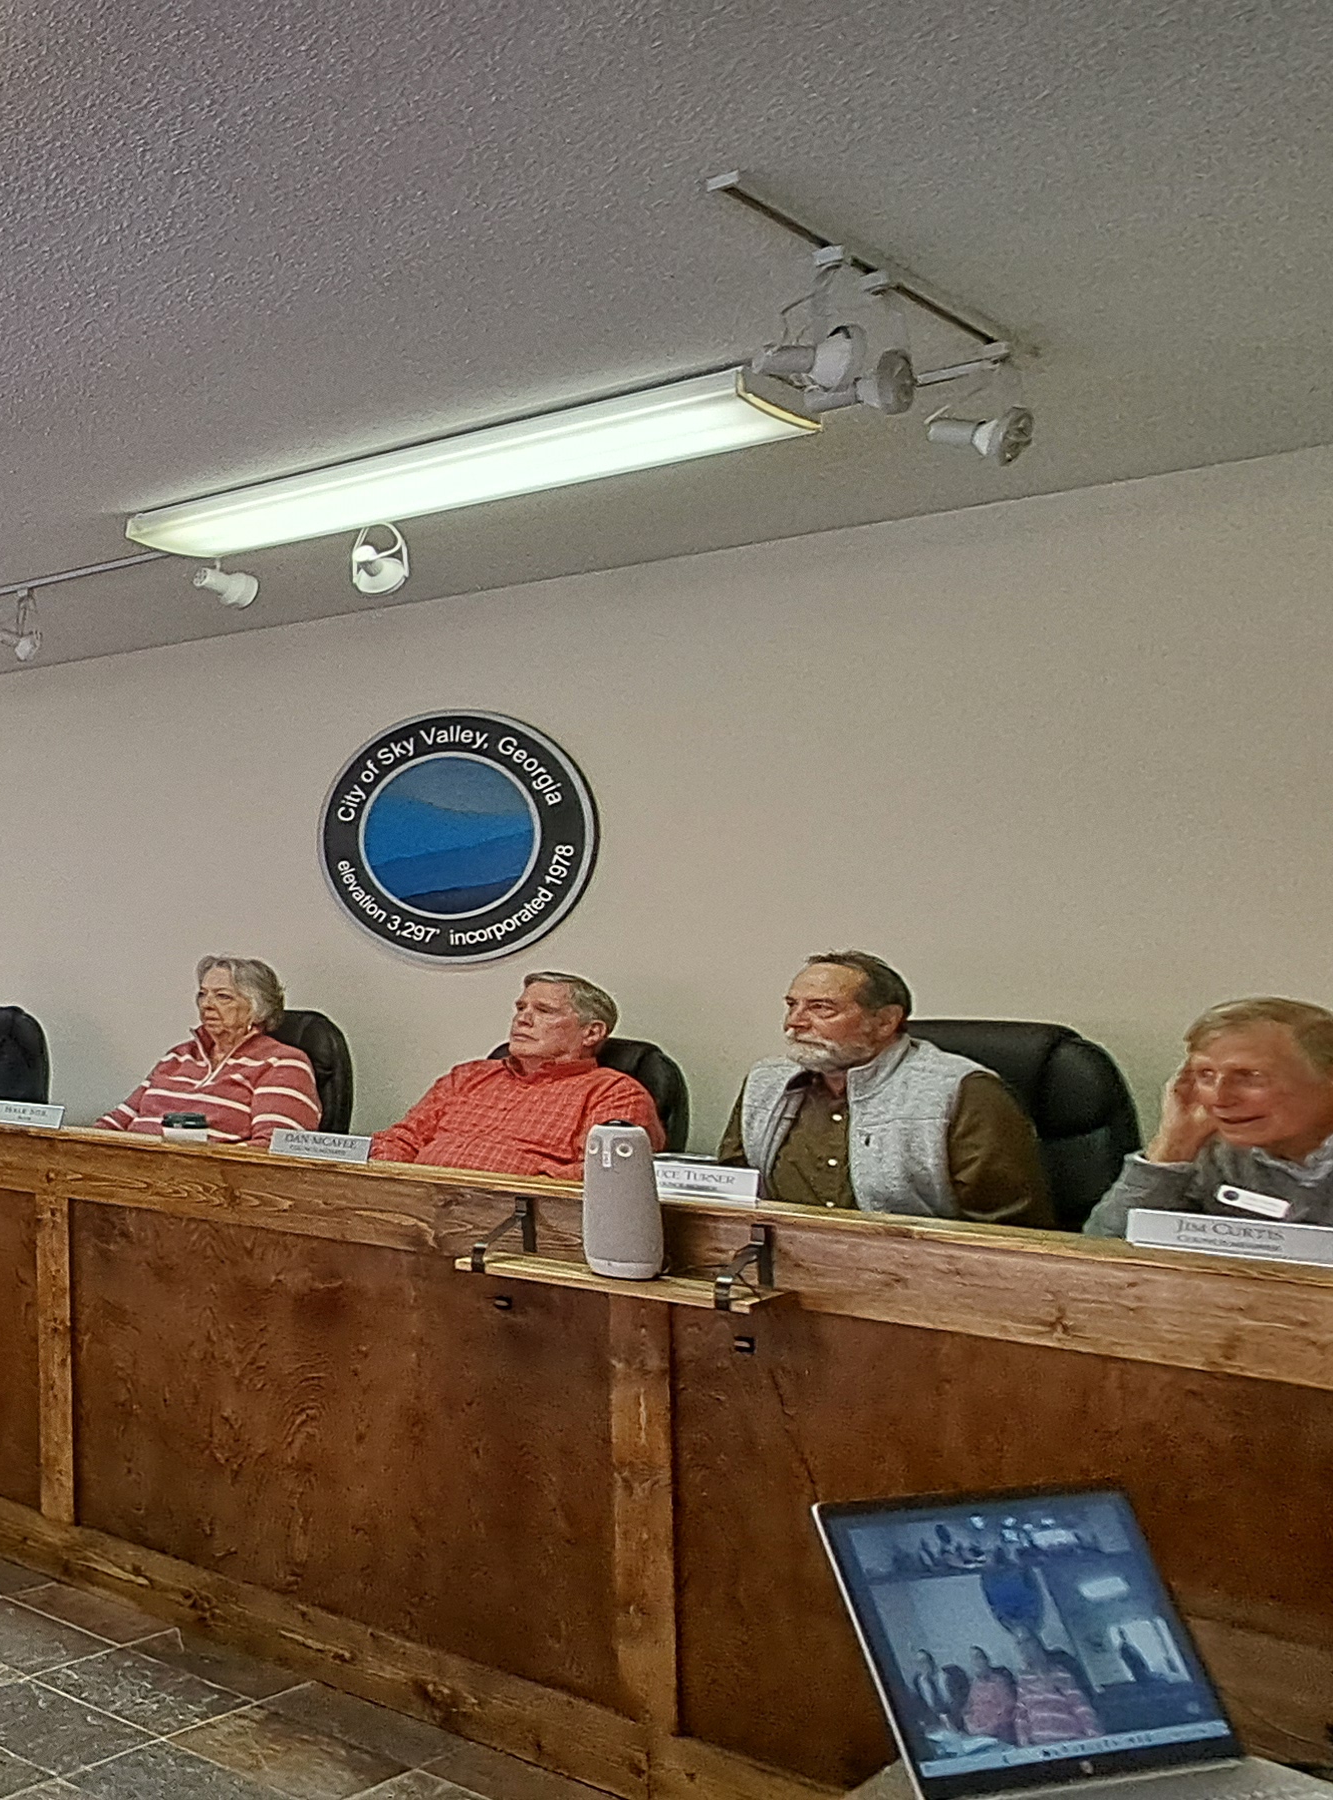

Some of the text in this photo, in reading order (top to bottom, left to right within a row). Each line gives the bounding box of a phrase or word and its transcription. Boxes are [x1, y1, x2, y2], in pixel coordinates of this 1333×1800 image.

[337, 725, 563, 822] City of Sky Valley, Georgia
[337, 844, 575, 946] elevation 3,297' incorporated 1978
[656, 1169, 736, 1185] UCE TURNER
